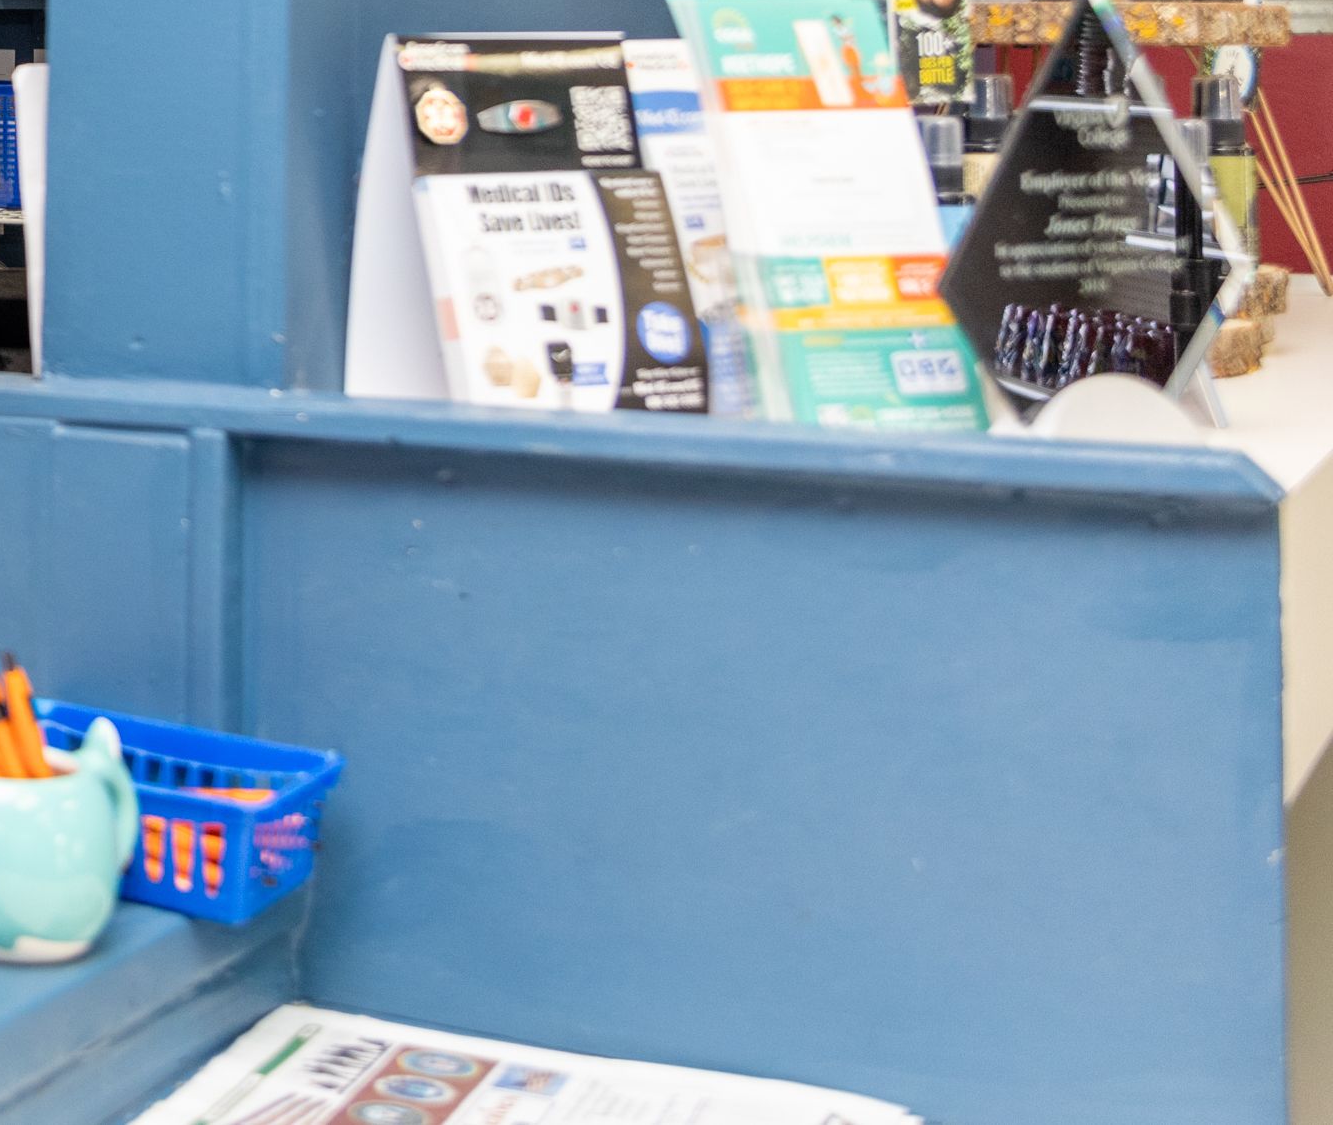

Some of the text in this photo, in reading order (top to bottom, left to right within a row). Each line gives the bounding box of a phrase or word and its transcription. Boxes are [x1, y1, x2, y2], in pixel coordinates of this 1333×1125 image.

[916, 32, 954, 56] 100+
[919, 69, 956, 85] BOTTLE
[1077, 128, 1131, 150] College
[466, 182, 576, 205] Medical IDs
[480, 212, 524, 233] Save
[1044, 215, 1092, 238] Jones
